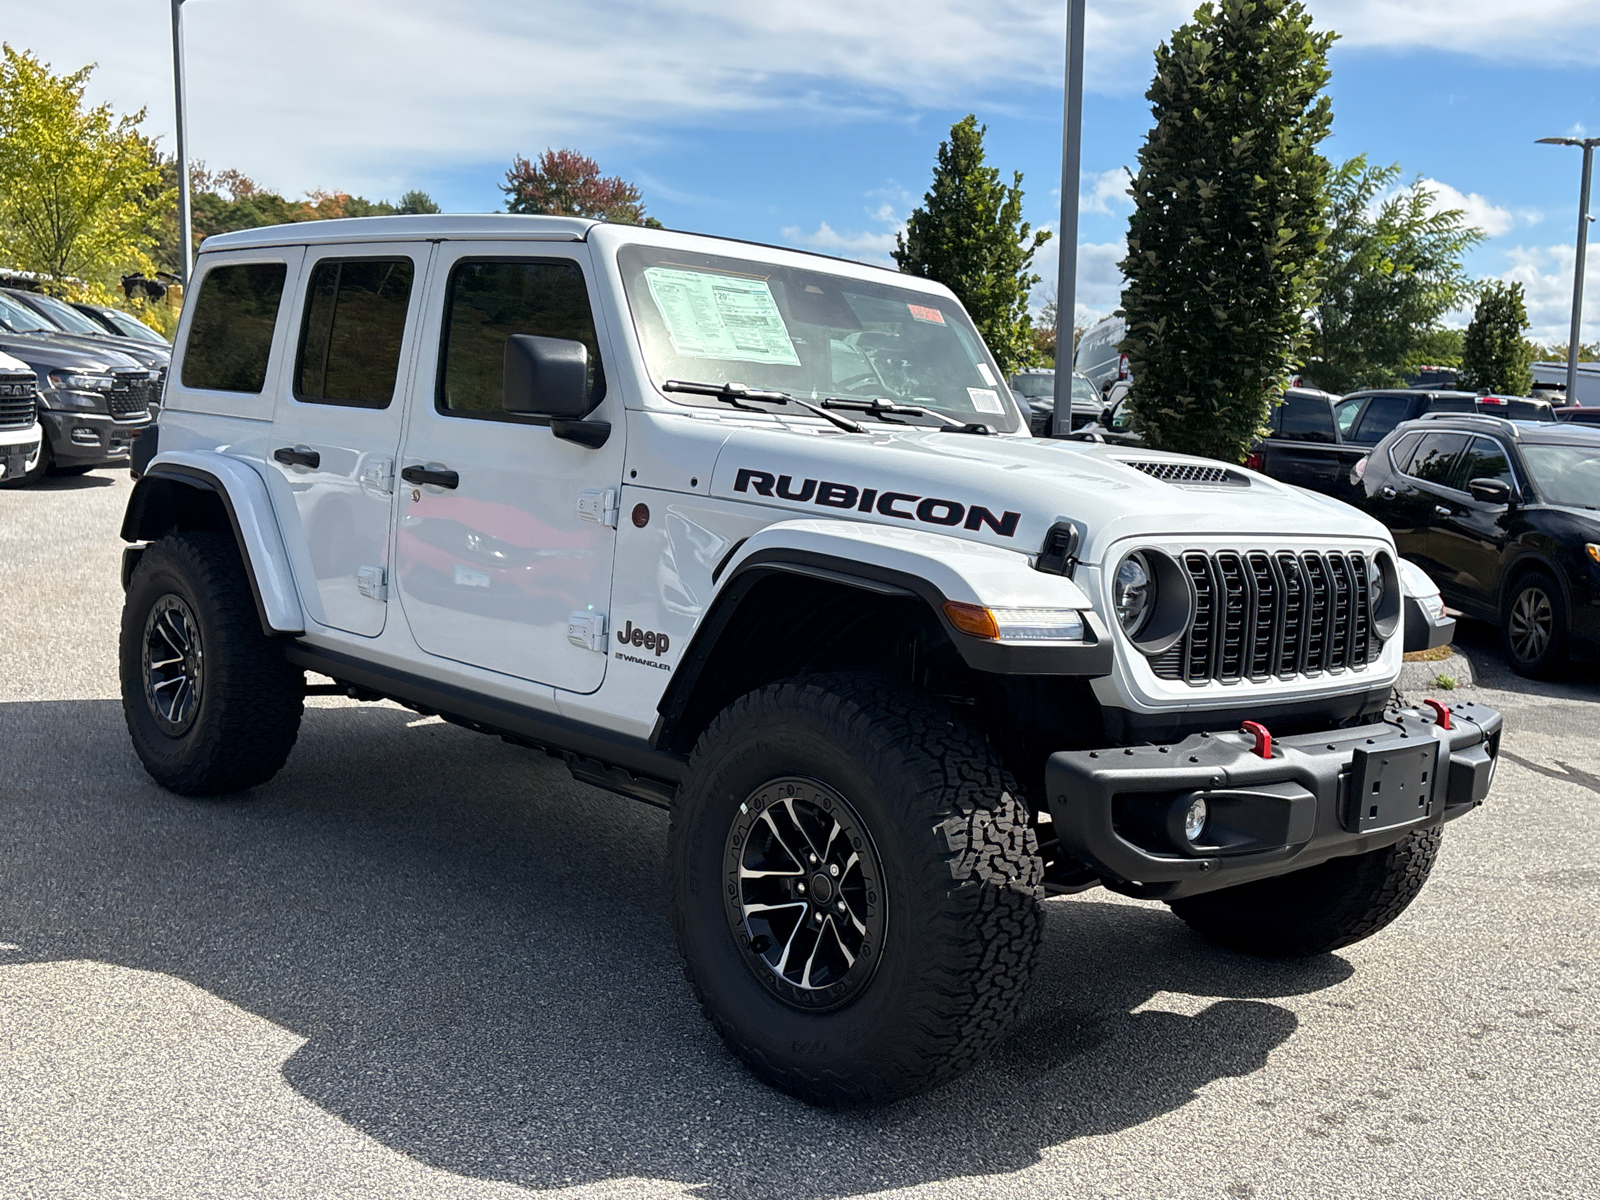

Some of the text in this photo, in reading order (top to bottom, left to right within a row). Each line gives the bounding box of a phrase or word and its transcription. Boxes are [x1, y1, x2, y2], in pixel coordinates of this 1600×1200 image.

[0, 385, 31, 395] RAM
[733, 468, 1021, 538] RUBICON
[617, 620, 670, 657] Jeep
[623, 654, 671, 671] WRANGLER
